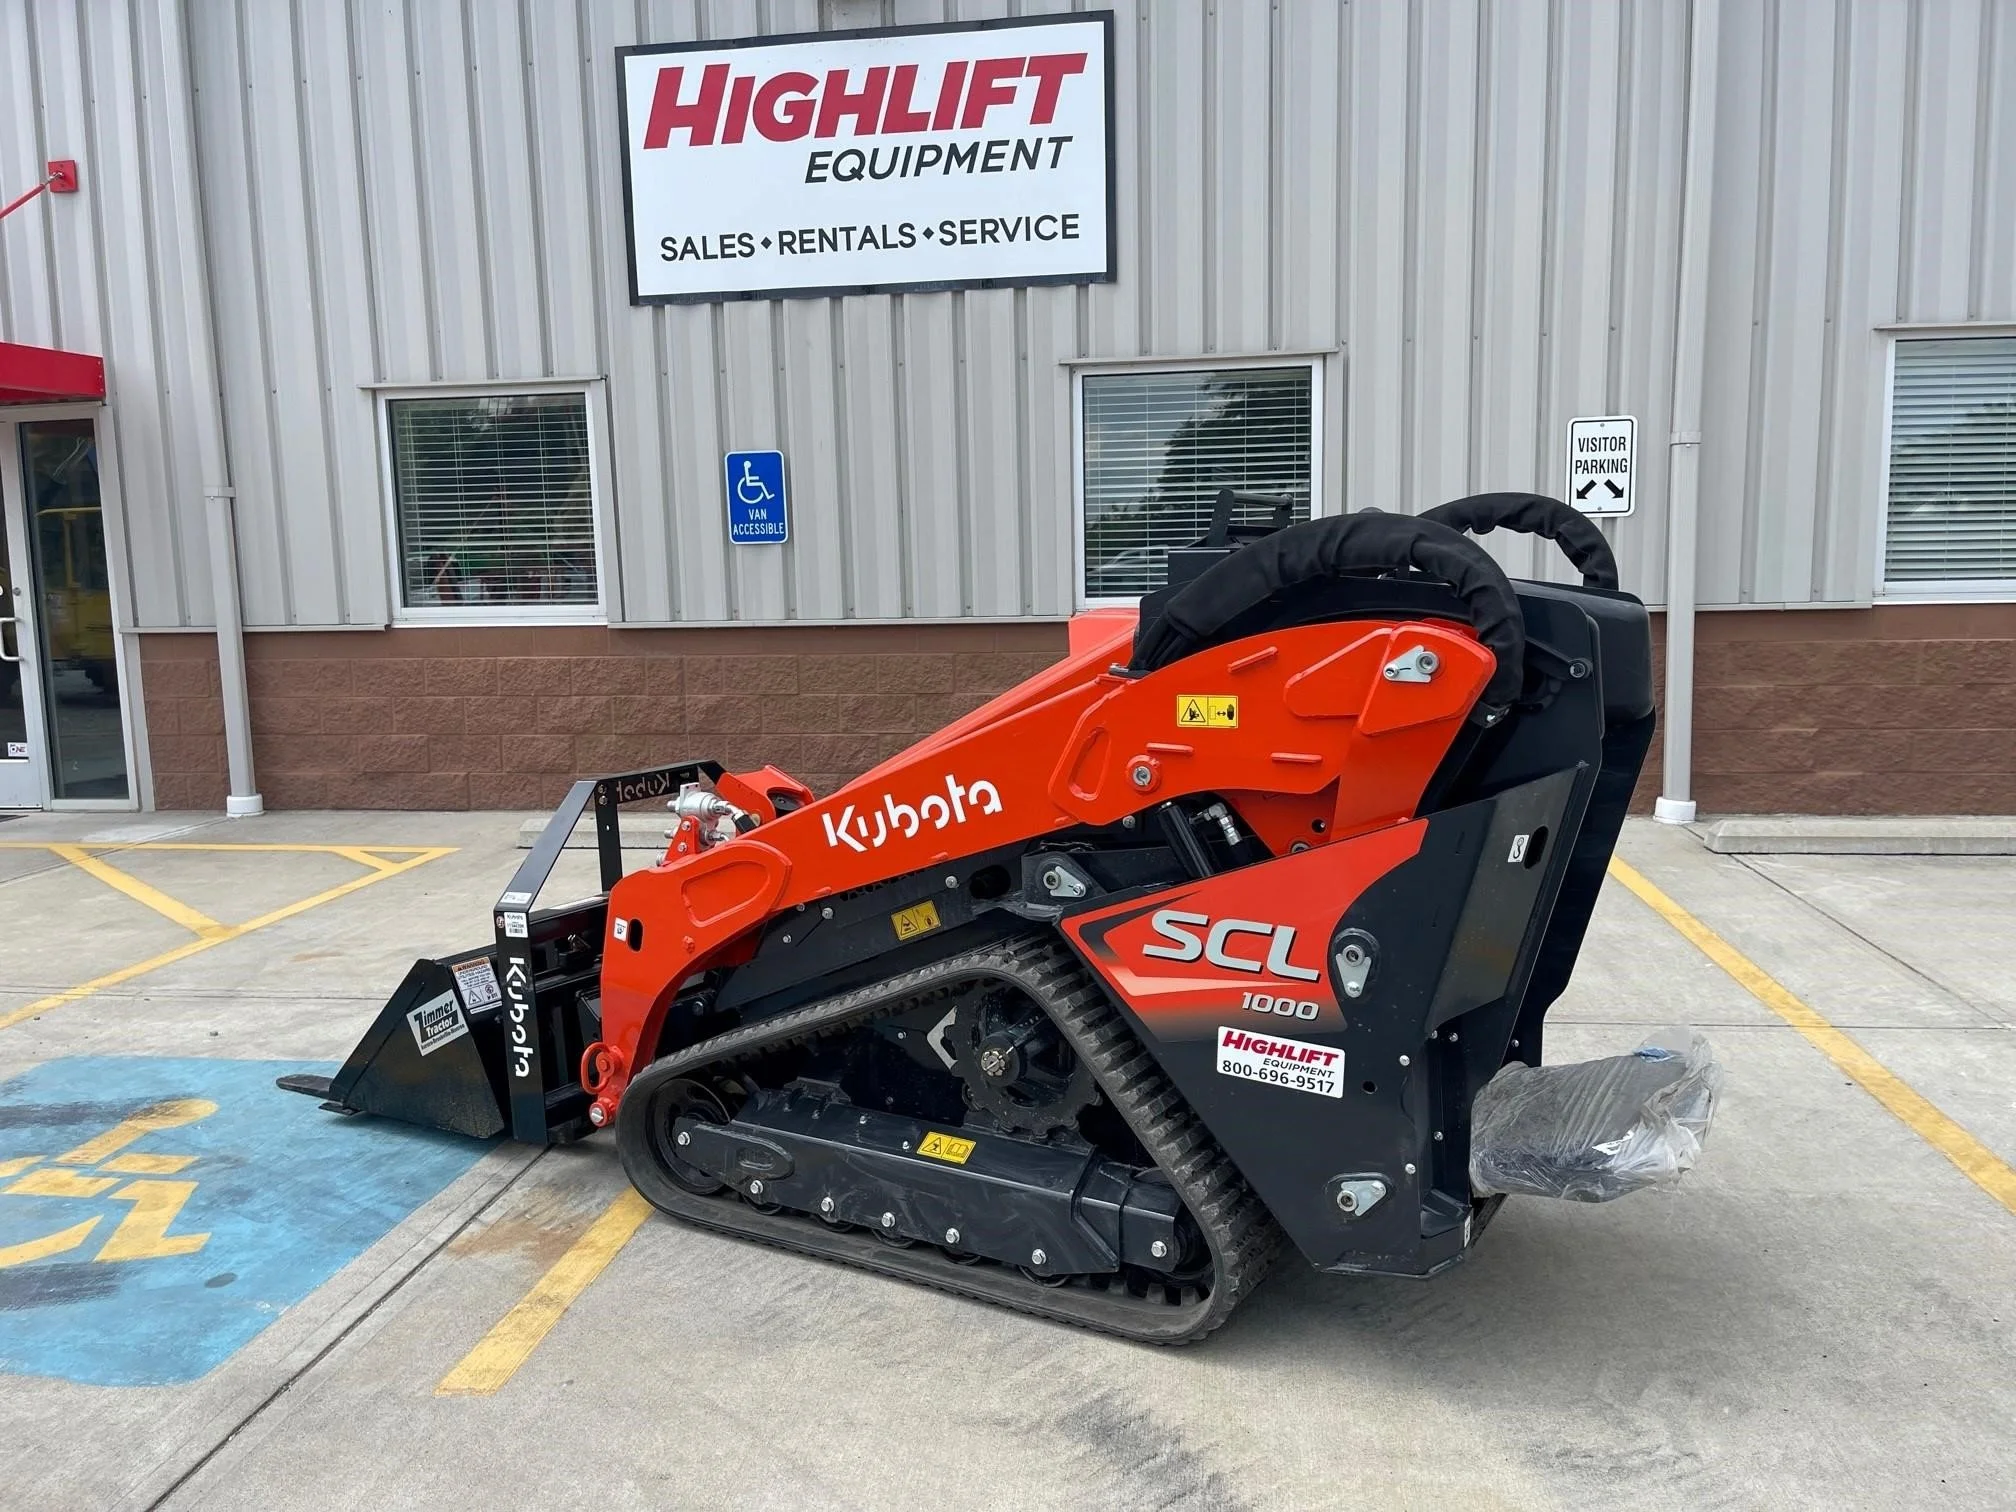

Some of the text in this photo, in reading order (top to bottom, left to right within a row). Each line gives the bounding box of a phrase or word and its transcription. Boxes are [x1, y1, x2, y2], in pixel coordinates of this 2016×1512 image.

[804, 136, 1073, 184] EQUIPMENT
[660, 214, 1080, 262] SALES RENTALS SERVICE
[1578, 436, 1626, 452] VISITOR
[1575, 458, 1628, 474] PARKING
[733, 522, 784, 535] ACCESSIBLE
[748, 508, 767, 520] VAN
[821, 774, 1003, 853] Kubota
[1142, 909, 1321, 983] SCL
[414, 1000, 454, 1034] Zimmer
[506, 957, 534, 1077] Kubota
[1241, 991, 1320, 1021] 1000
[426, 1016, 453, 1037] Tractor
[1222, 1060, 1335, 1093] 800-696-9517
[1263, 1058, 1335, 1078] EQUIPMENT
